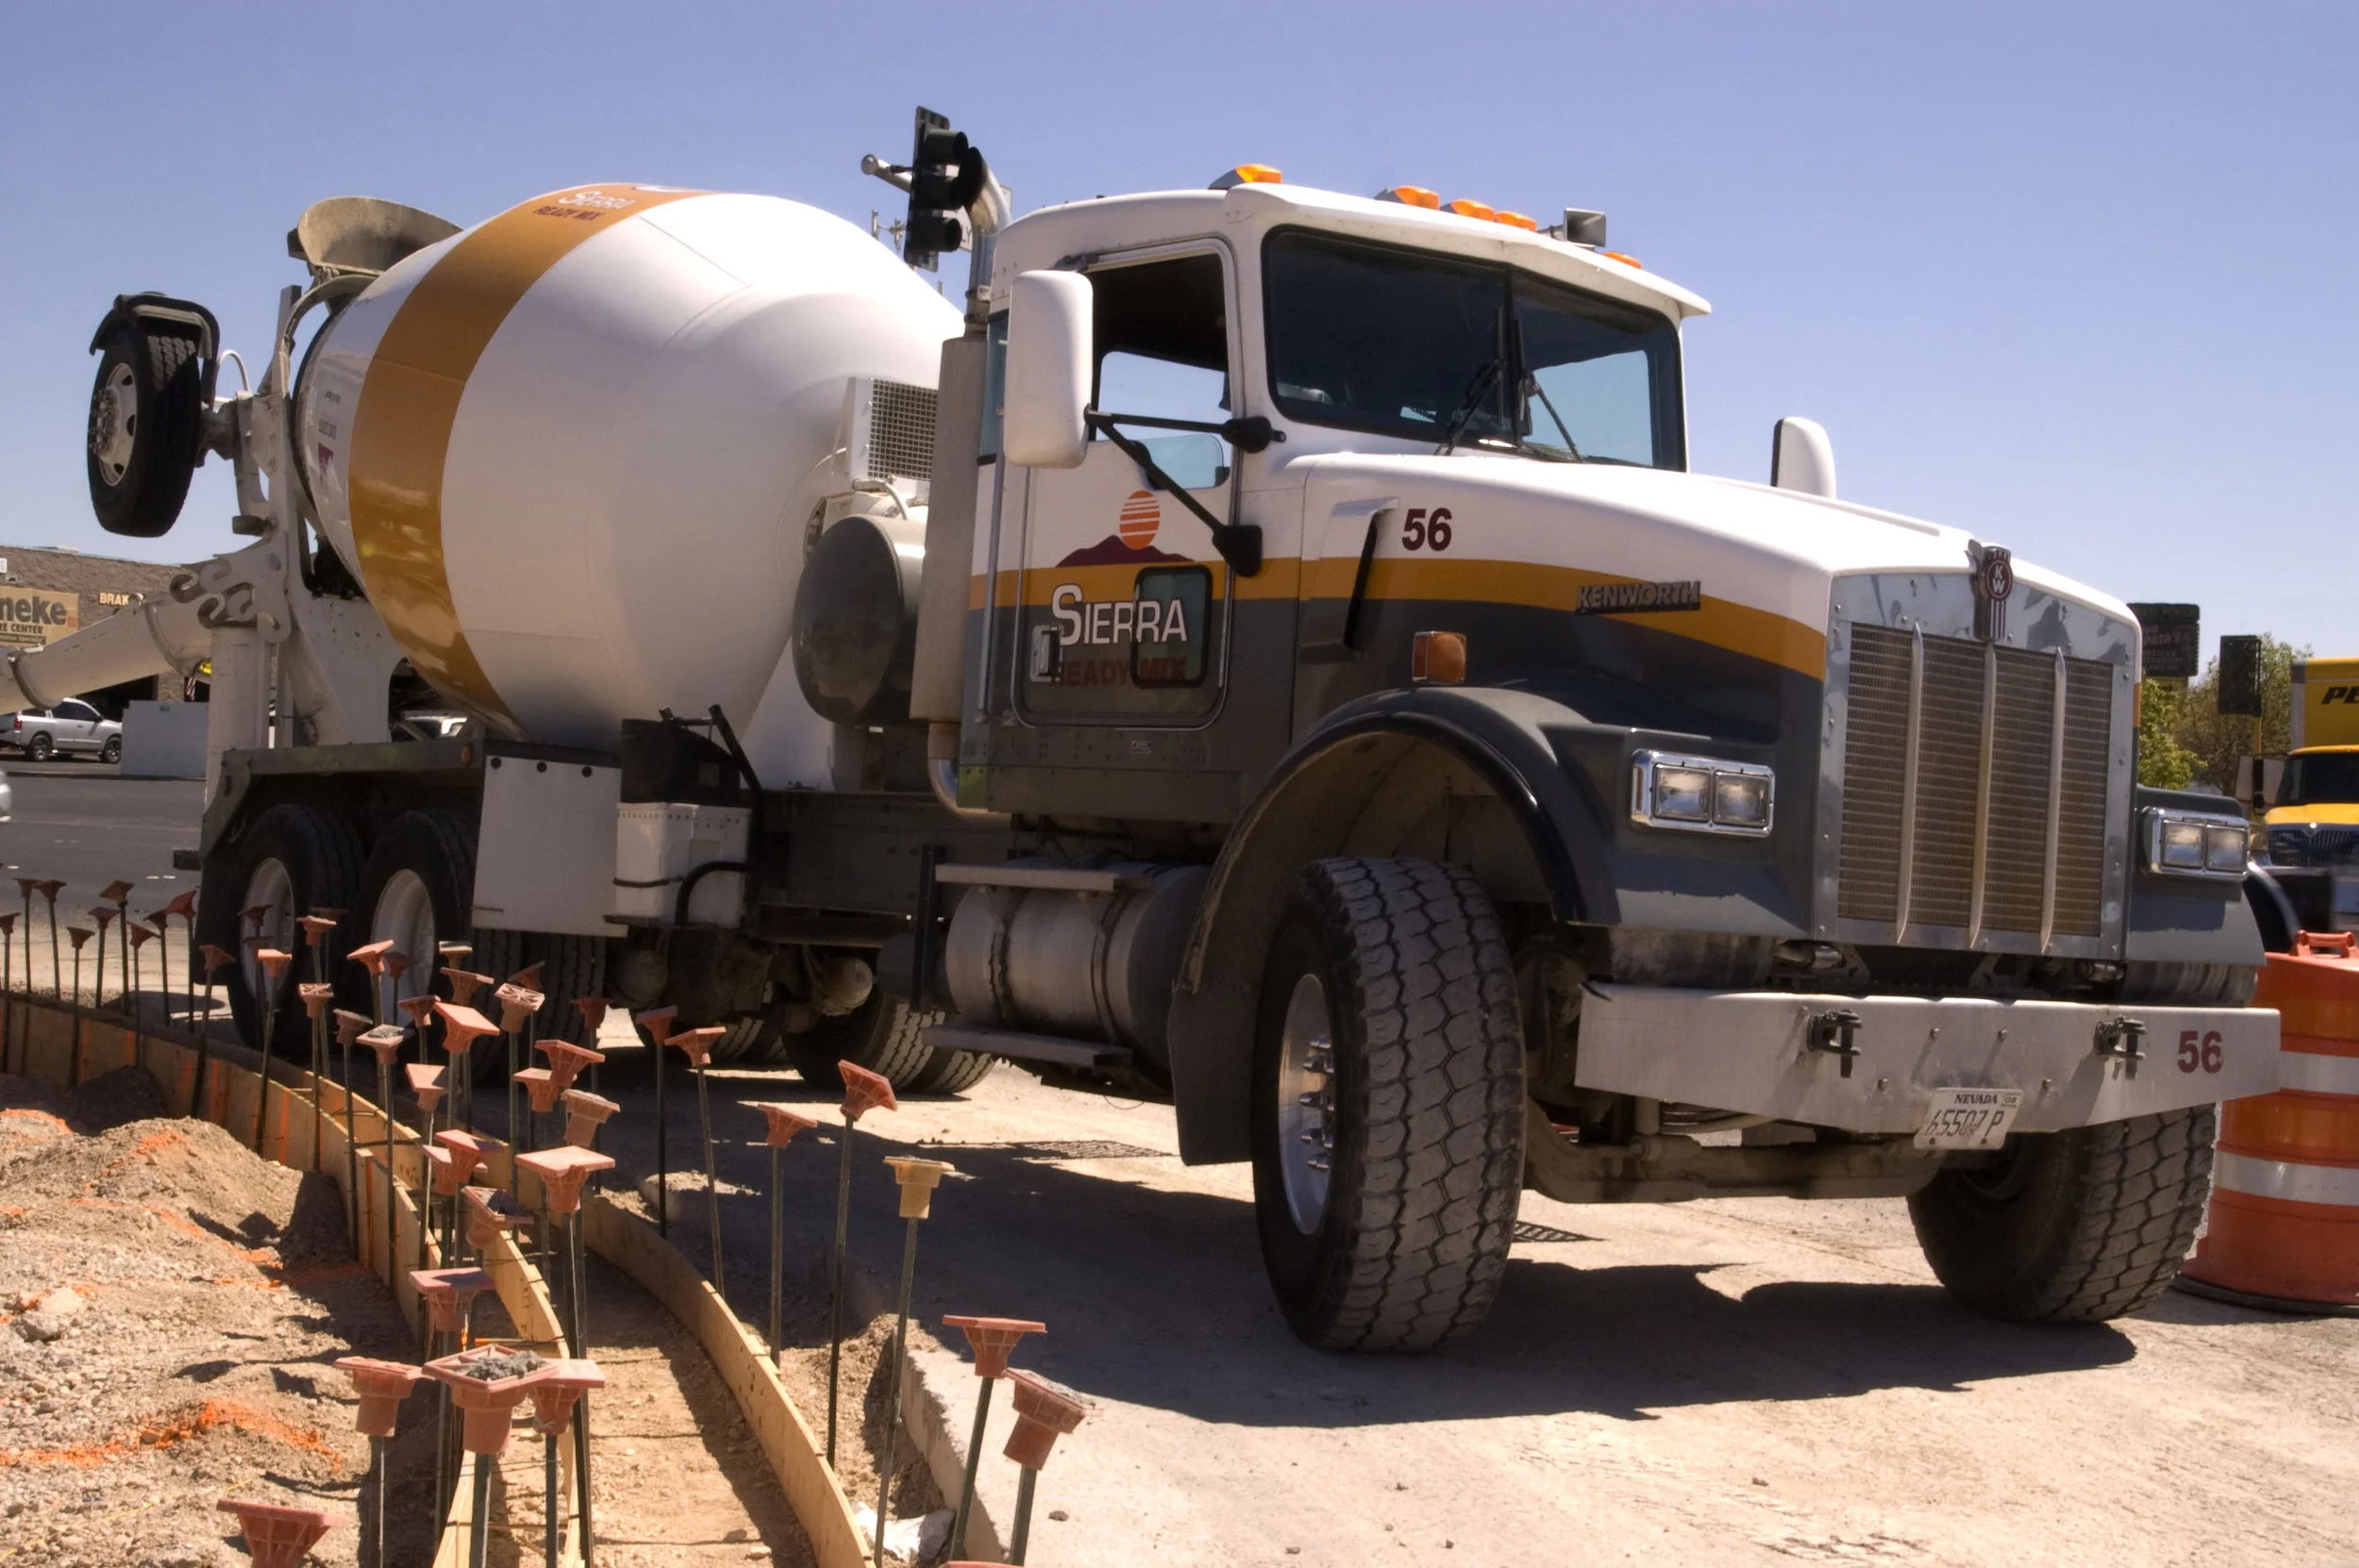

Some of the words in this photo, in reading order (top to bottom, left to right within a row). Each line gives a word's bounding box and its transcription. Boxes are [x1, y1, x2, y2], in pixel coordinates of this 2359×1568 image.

[1401, 508, 1452, 552] 56
[99, 592, 130, 607] BRAK
[1578, 581, 1701, 609] KENWORTH
[1051, 582, 1189, 646] SIERRA
[10, 624, 43, 634] CENTER
[1139, 657, 1187, 681] MIX
[2177, 1030, 2224, 1075] 56
[1954, 1093, 1999, 1105] NEVADA
